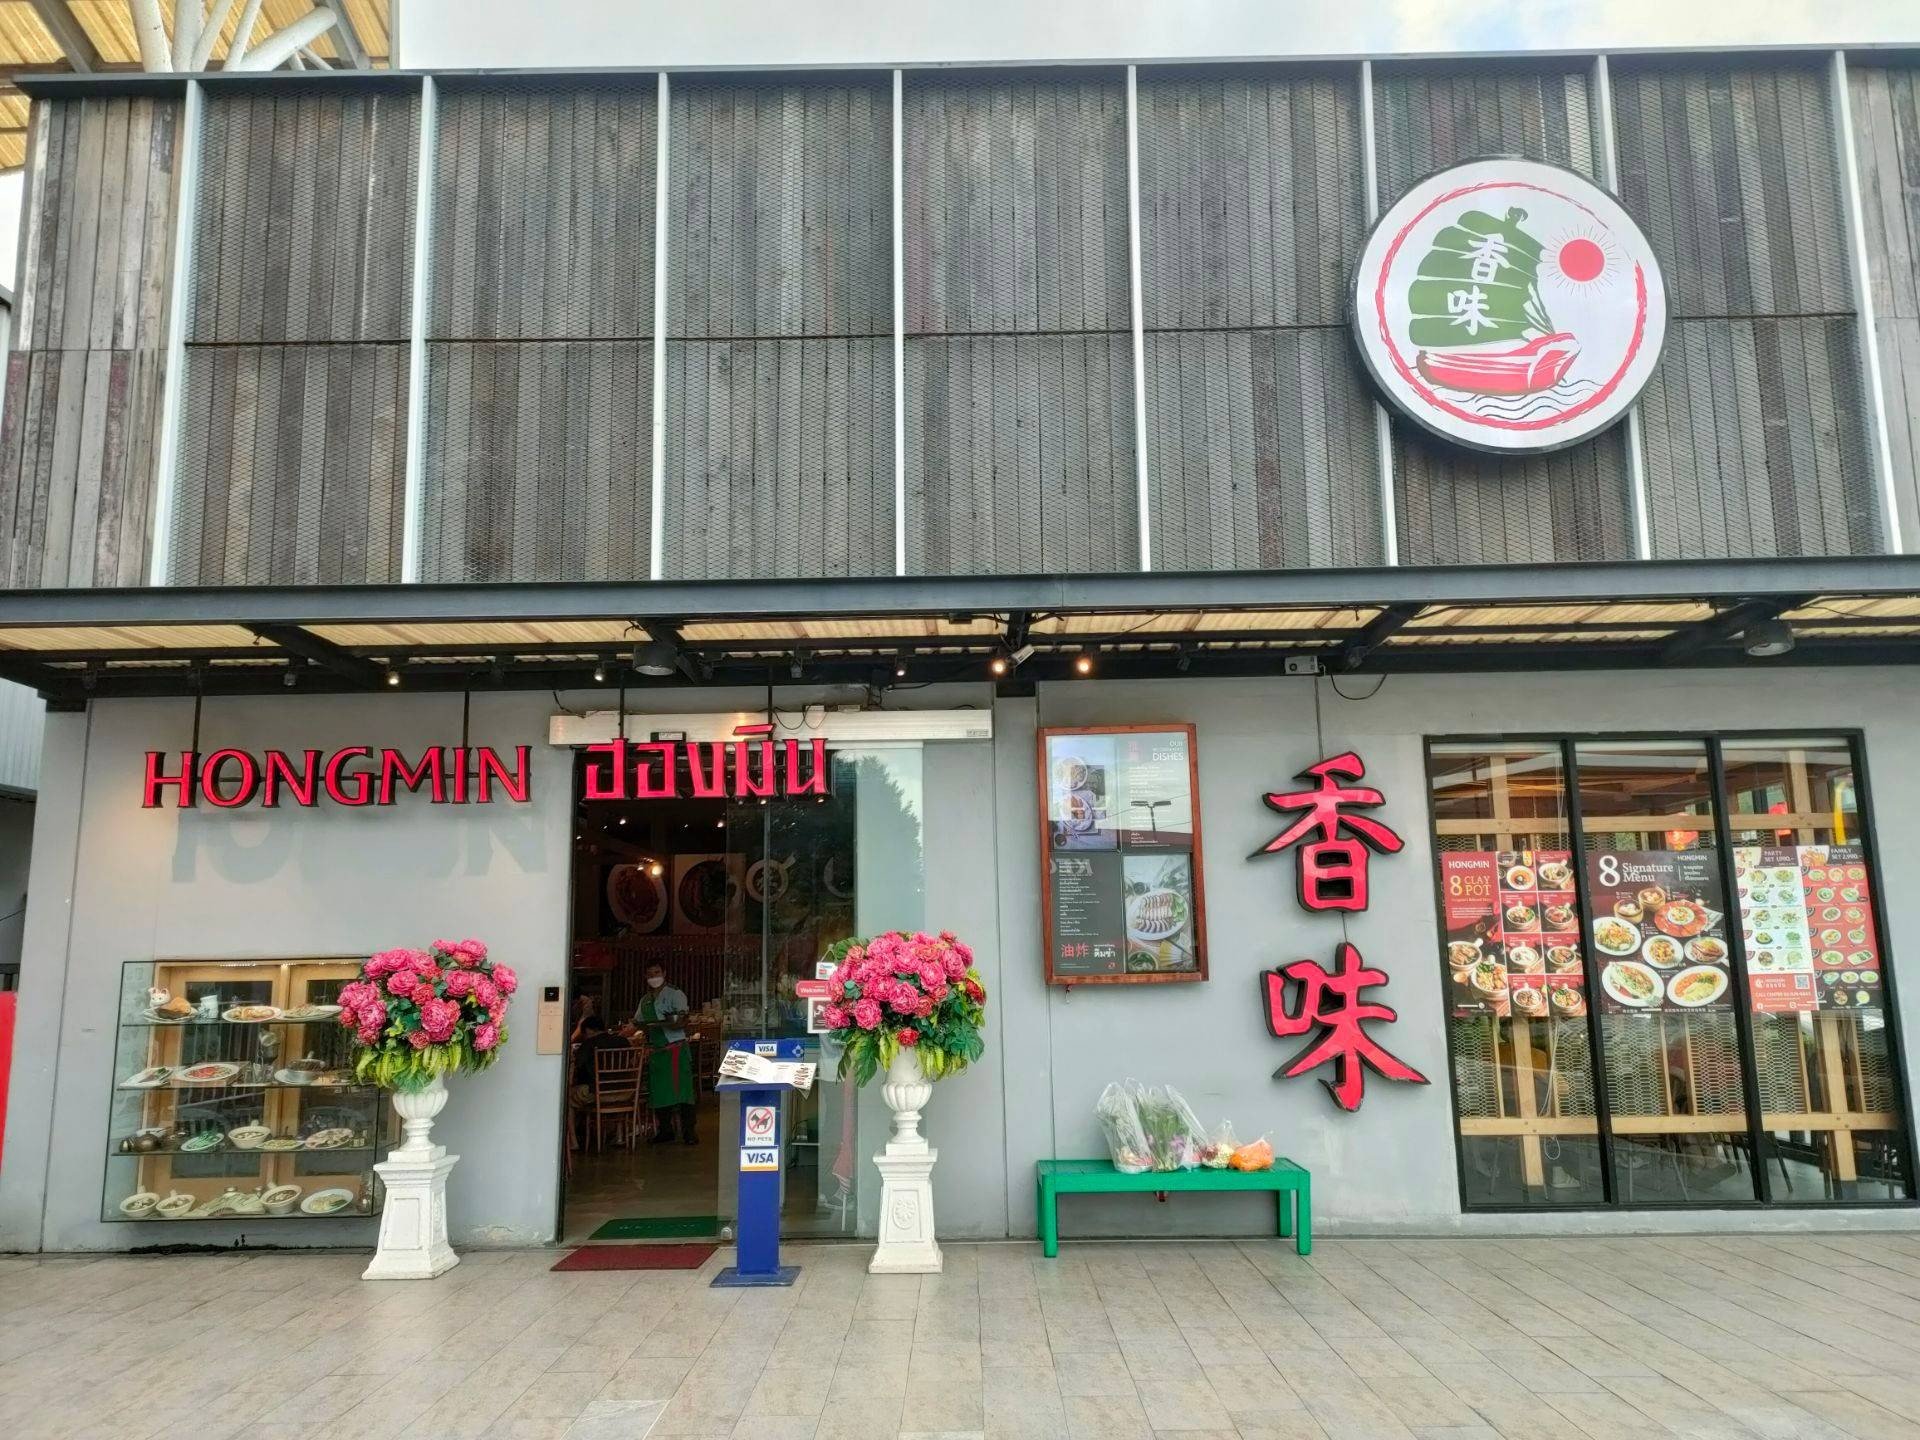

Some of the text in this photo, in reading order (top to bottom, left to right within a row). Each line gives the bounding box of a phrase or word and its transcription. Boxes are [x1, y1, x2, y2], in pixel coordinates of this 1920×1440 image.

[1446, 233, 1513, 336] 香味
[1152, 751, 1184, 761] DISHES
[142, 745, 531, 809] HONGMIN
[1448, 860, 1490, 870] HONGMIN
[1599, 855, 1674, 887] 8 Signature
[1622, 872, 1656, 883] Menu
[1449, 875, 1491, 897] 8 CLAY
[1465, 885, 1492, 896] POT
[1247, 751, 1431, 1112] 香味
[758, 1045, 775, 1053] VISA
[747, 1152, 774, 1163] VISA
